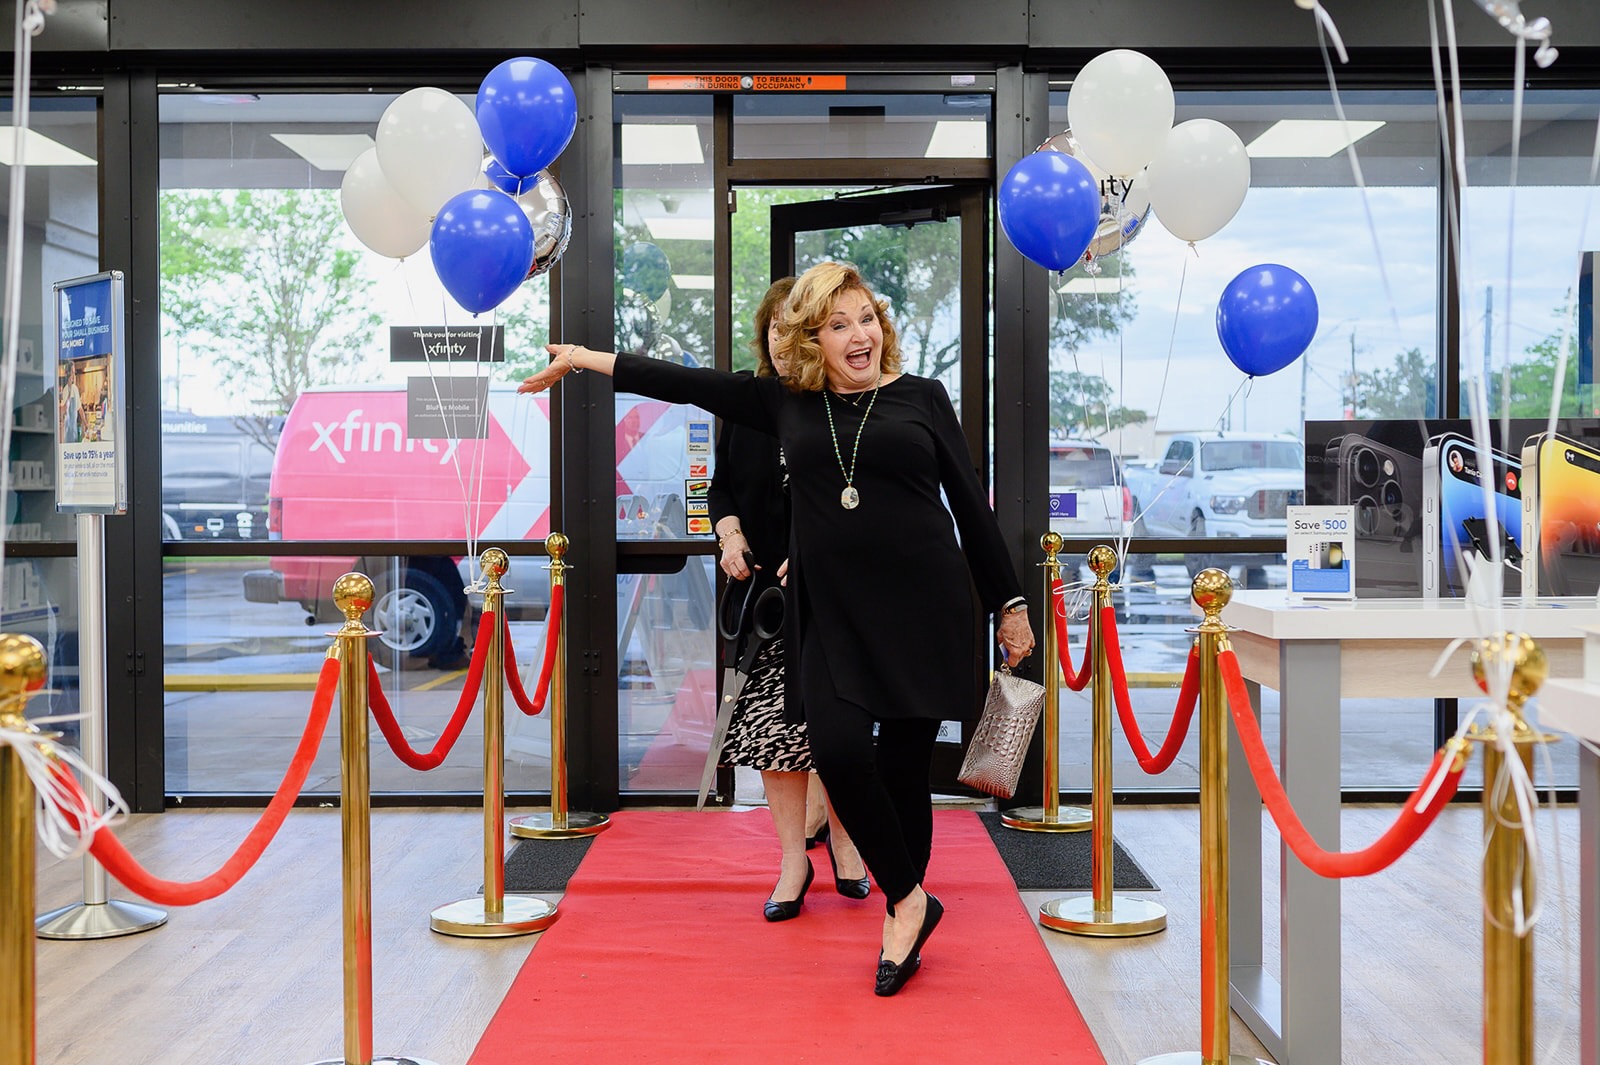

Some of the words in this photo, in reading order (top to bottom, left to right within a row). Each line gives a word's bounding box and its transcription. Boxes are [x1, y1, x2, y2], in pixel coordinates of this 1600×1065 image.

[1100, 174, 1134, 203] ity
[73, 327, 87, 338] SMALL
[87, 324, 110, 335] BUSINESS
[458, 331, 482, 339] visiting
[428, 342, 467, 356] xfinity
[63, 451, 75, 459] Save
[75, 452, 81, 461] up
[82, 451, 88, 459] to
[88, 450, 98, 459] 75%
[103, 451, 115, 460] year
[1294, 519, 1320, 530] Save
[1322, 519, 1347, 530] $500
